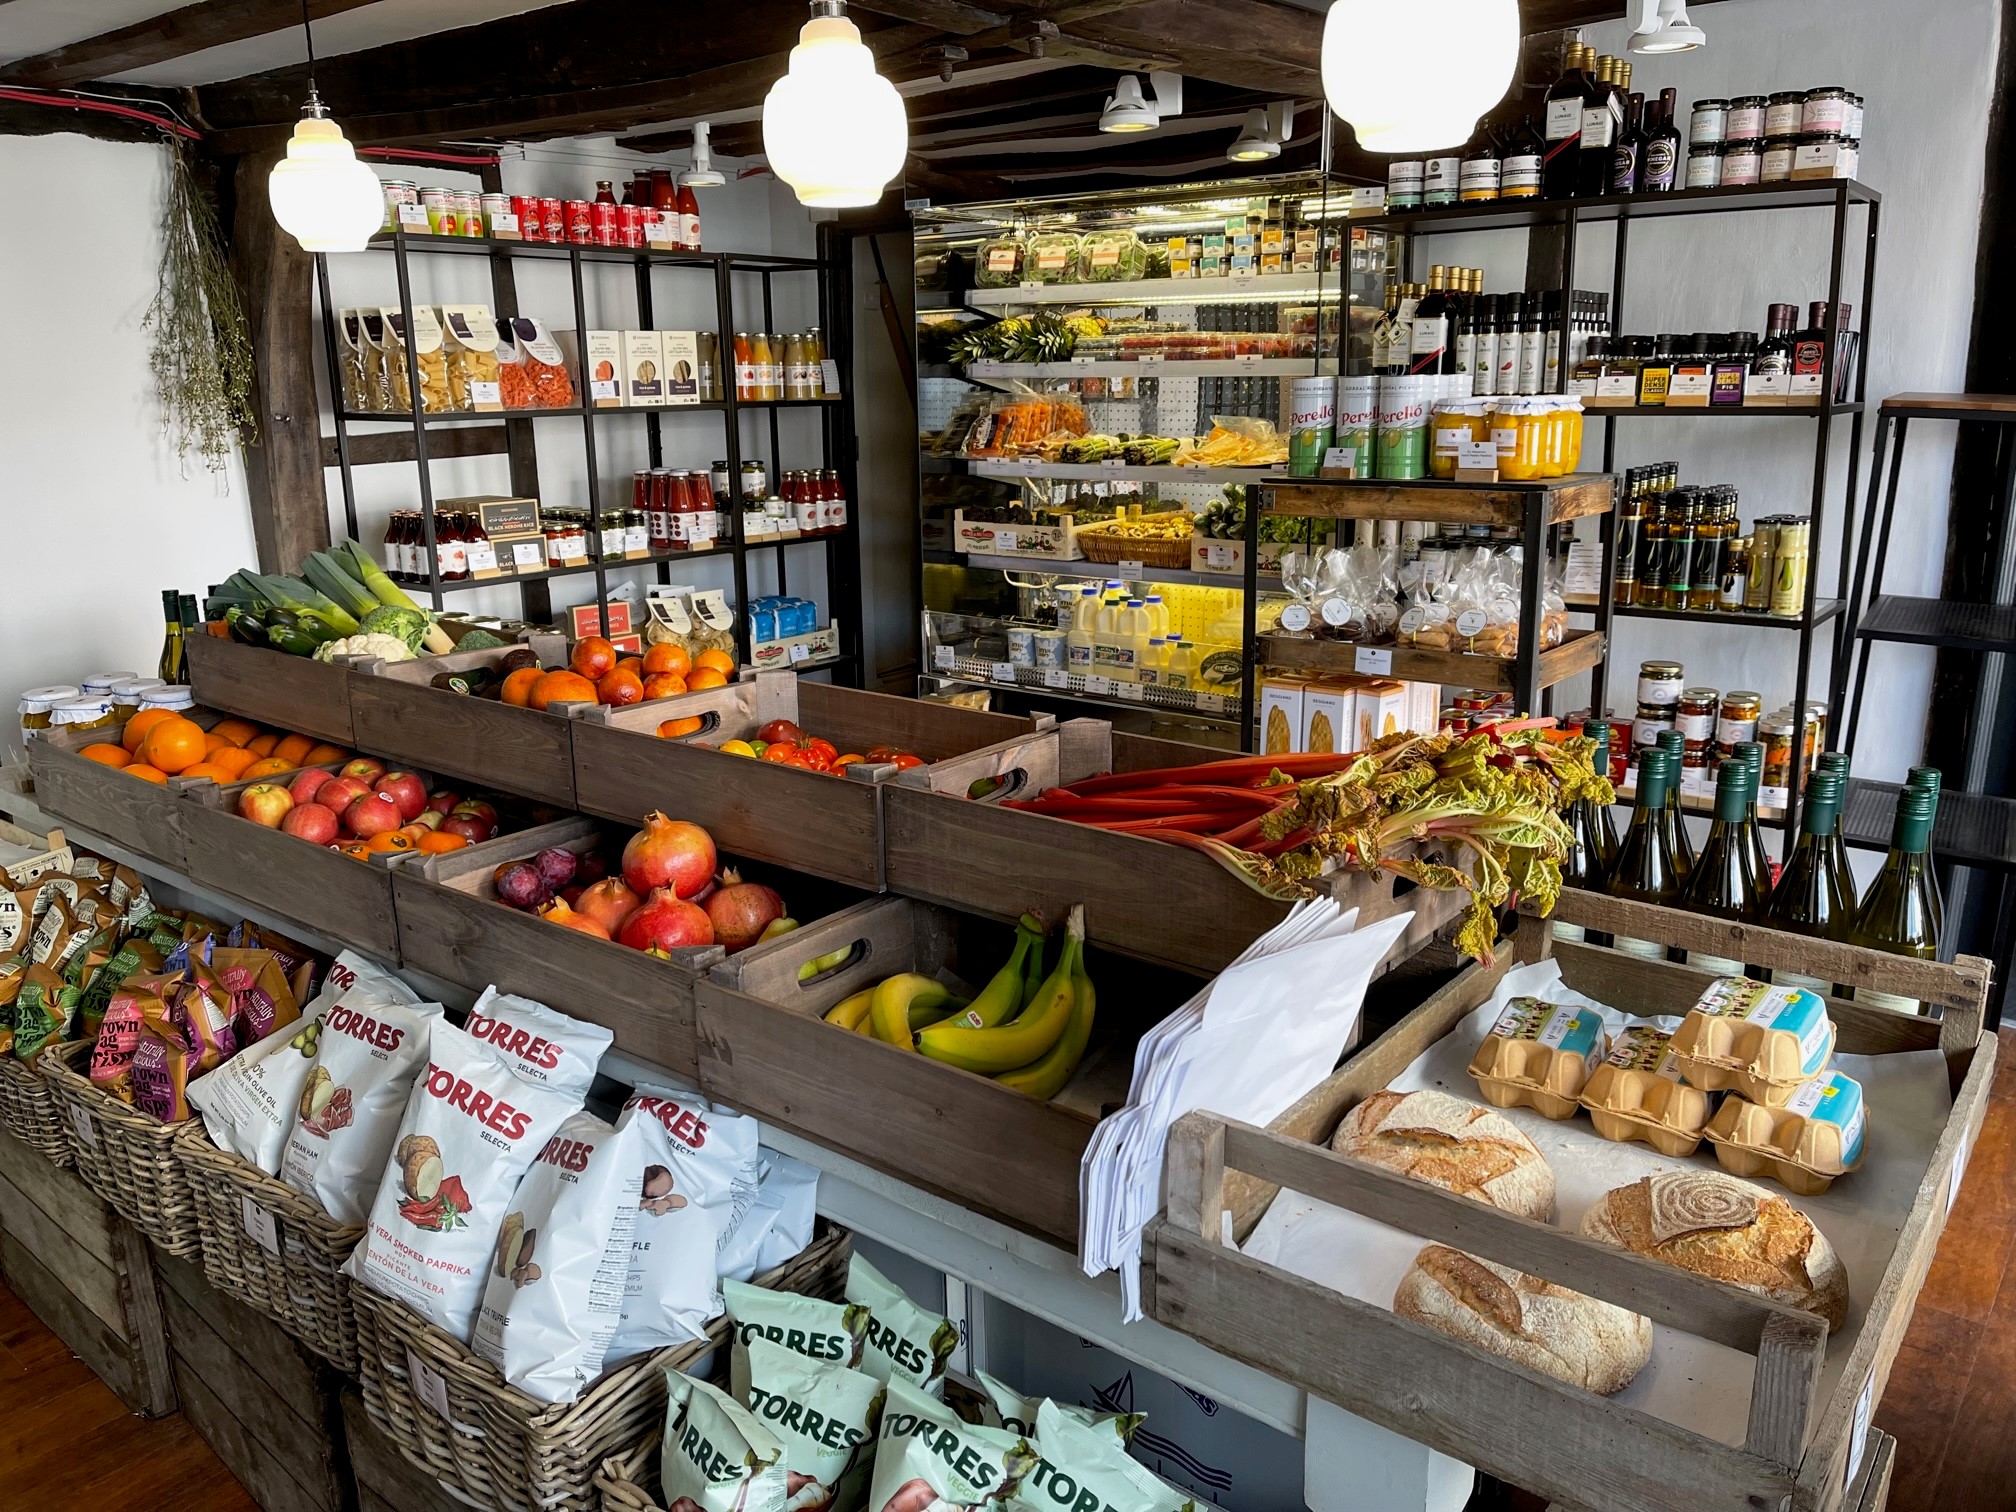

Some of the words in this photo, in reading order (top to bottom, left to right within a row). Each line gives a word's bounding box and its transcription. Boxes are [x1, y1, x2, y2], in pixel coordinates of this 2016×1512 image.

[1291, 404, 1334, 426] Perelló
[1342, 405, 1380, 425] Perell
[100, 1020, 140, 1034] rown
[326, 1005, 404, 1051] TORRES
[465, 1010, 564, 1070] TORRES
[370, 1050, 388, 1061] SELECTA
[134, 1068, 168, 1085] rown
[517, 1064, 547, 1082] SELECTA
[244, 1087, 263, 1108] VIRGEN
[262, 1105, 283, 1128] EXTRA
[252, 1080, 268, 1099] OLIVE
[266, 1096, 277, 1109] OIL
[422, 1062, 533, 1141] TORRES
[624, 1096, 711, 1149] ORRES
[306, 1150, 319, 1160] HAM
[480, 1131, 512, 1153] SELECTA
[536, 1136, 594, 1173] ORRES
[559, 1172, 579, 1185] SELECTA
[376, 1226, 392, 1243] VERA
[393, 1240, 423, 1263] SMOKED
[426, 1258, 471, 1276] PAPRIKA
[386, 1254, 411, 1270] PICANTE
[394, 1250, 406, 1260] HOT
[396, 1266, 406, 1277] DE
[408, 1273, 418, 1283] LA
[422, 1279, 444, 1295] VERA
[734, 1320, 844, 1360] TORRES
[890, 1364, 918, 1384] VEGGIE
[750, 1386, 865, 1450] TORRES
[883, 1412, 998, 1490] TORRES
[947, 1474, 980, 1503] VEGGIE
